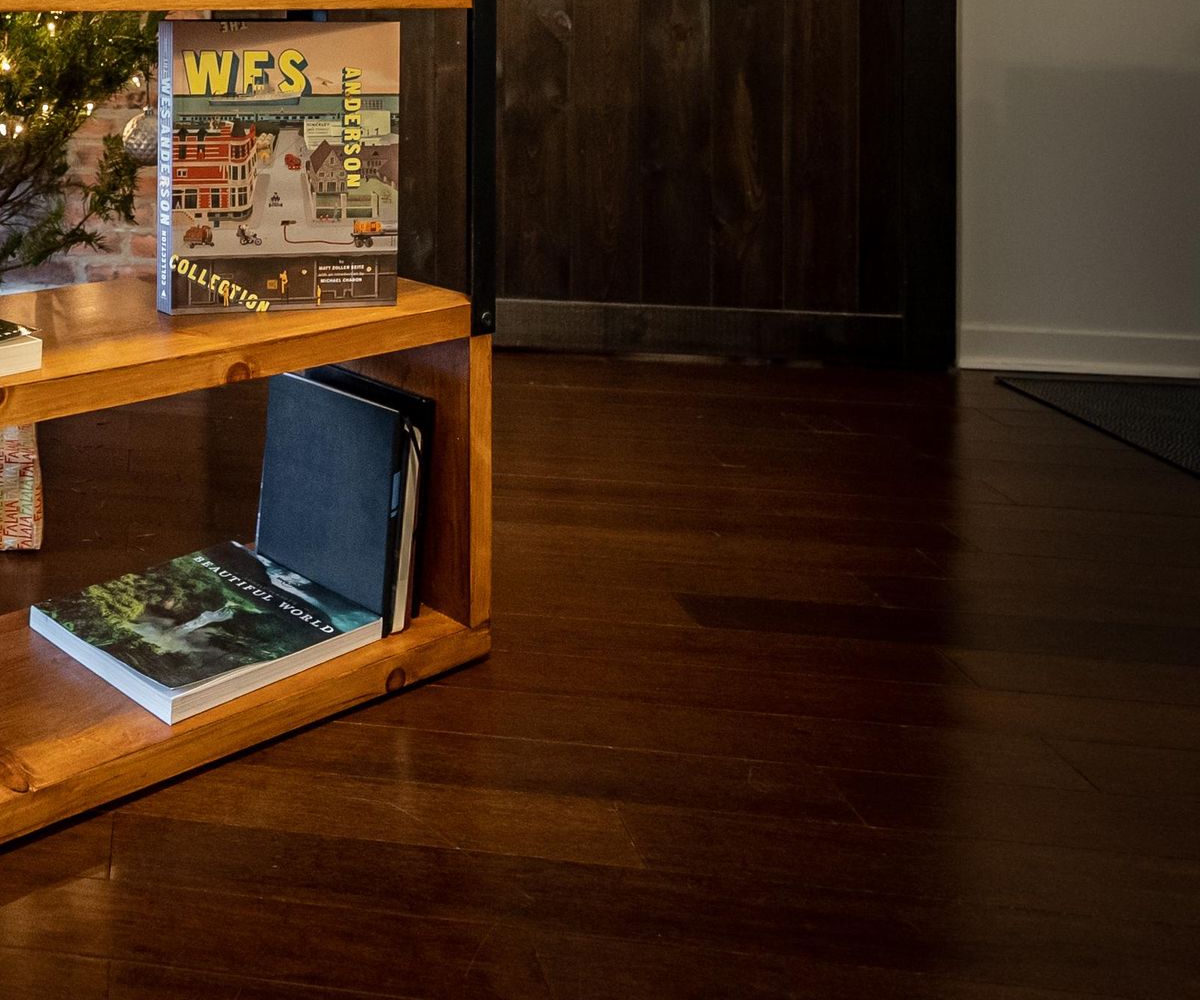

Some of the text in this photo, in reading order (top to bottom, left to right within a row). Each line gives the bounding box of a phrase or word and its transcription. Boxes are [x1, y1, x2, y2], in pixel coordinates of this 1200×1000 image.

[161, 78, 171, 119] WES
[183, 49, 310, 96] WES
[342, 66, 362, 188] ANDERSON
[160, 125, 171, 226] ANDERSON
[169, 254, 271, 313] COLLECTION
[3, 501, 18, 537] FALALA
[193, 555, 335, 634] BEAUTIFUL WORLD
